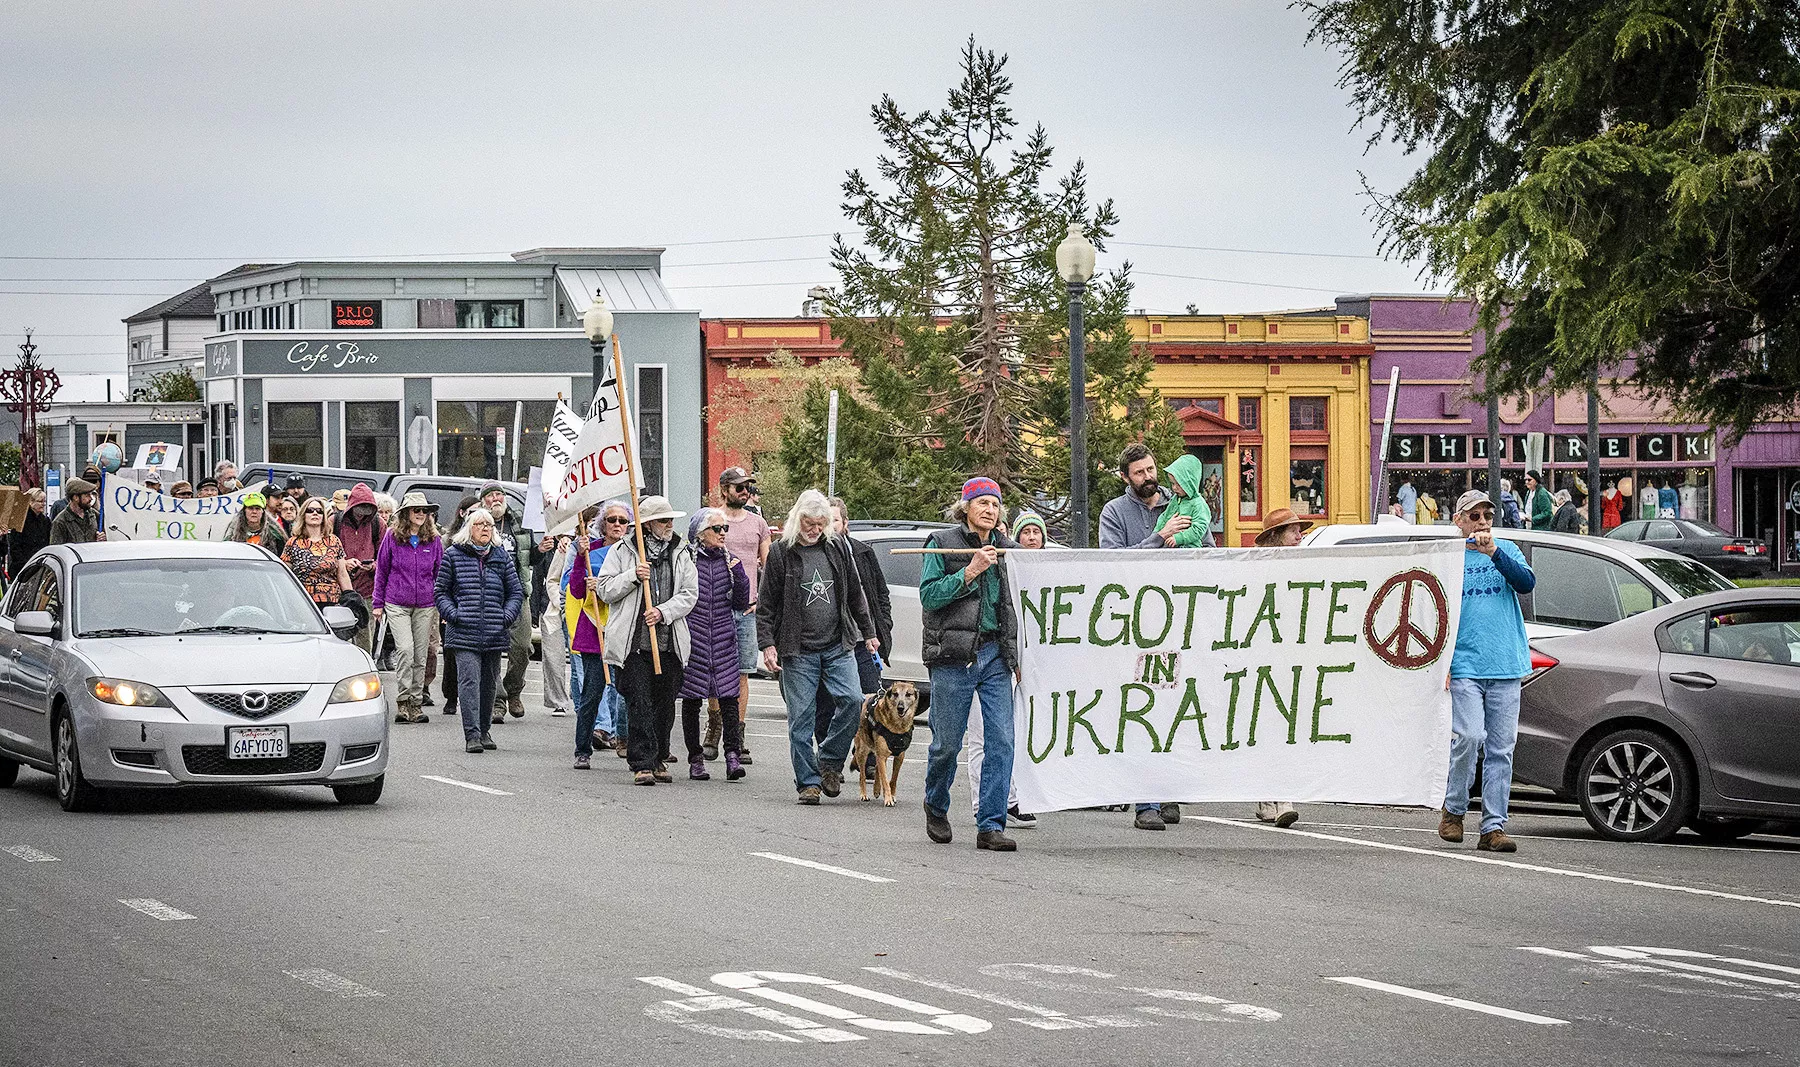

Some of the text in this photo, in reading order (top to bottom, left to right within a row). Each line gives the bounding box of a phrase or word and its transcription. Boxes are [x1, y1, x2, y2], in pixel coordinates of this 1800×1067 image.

[336, 306, 374, 318] BRIO
[286, 341, 379, 372] Cafe Brio
[156, 520, 197, 540] FOR
[1019, 580, 1368, 651] NEGOTIATE
[1142, 652, 1178, 685] IN
[1027, 662, 1356, 764] UKRAINE
[233, 738, 284, 753] 6AFY078
